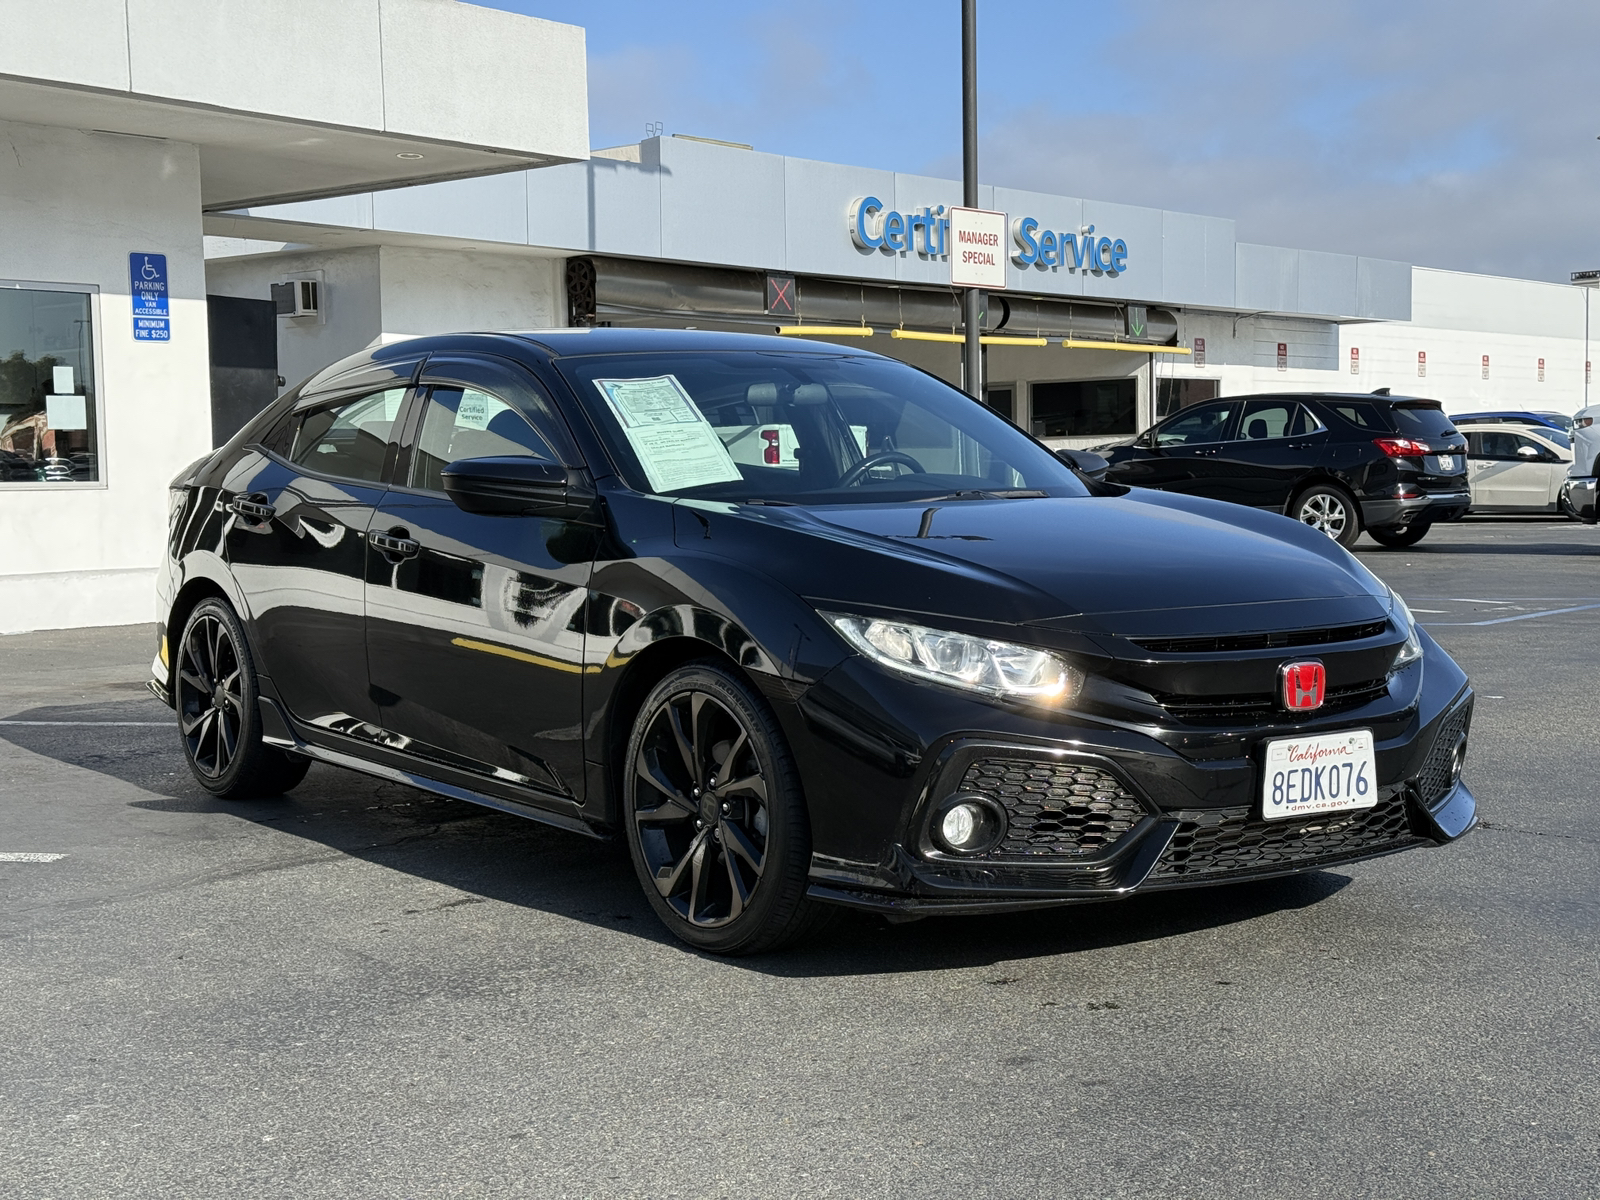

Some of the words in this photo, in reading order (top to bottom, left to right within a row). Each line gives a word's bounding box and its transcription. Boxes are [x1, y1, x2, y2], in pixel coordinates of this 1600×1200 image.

[850, 196, 949, 256] Certi
[1013, 216, 1128, 272] Service
[958, 229, 999, 247] MANAGER
[962, 250, 996, 266] SPECIAL
[134, 280, 165, 291] PARKING
[141, 291, 159, 301] ONLY
[138, 319, 165, 329] MINIMUM
[135, 329, 150, 338] FINE
[151, 330, 168, 339] $250
[459, 405, 485, 414] Certified
[461, 413, 483, 421] Service
[1288, 742, 1354, 765] California
[1272, 760, 1369, 805] 8EDK076
[1291, 800, 1349, 812] dmv.ca.gov
